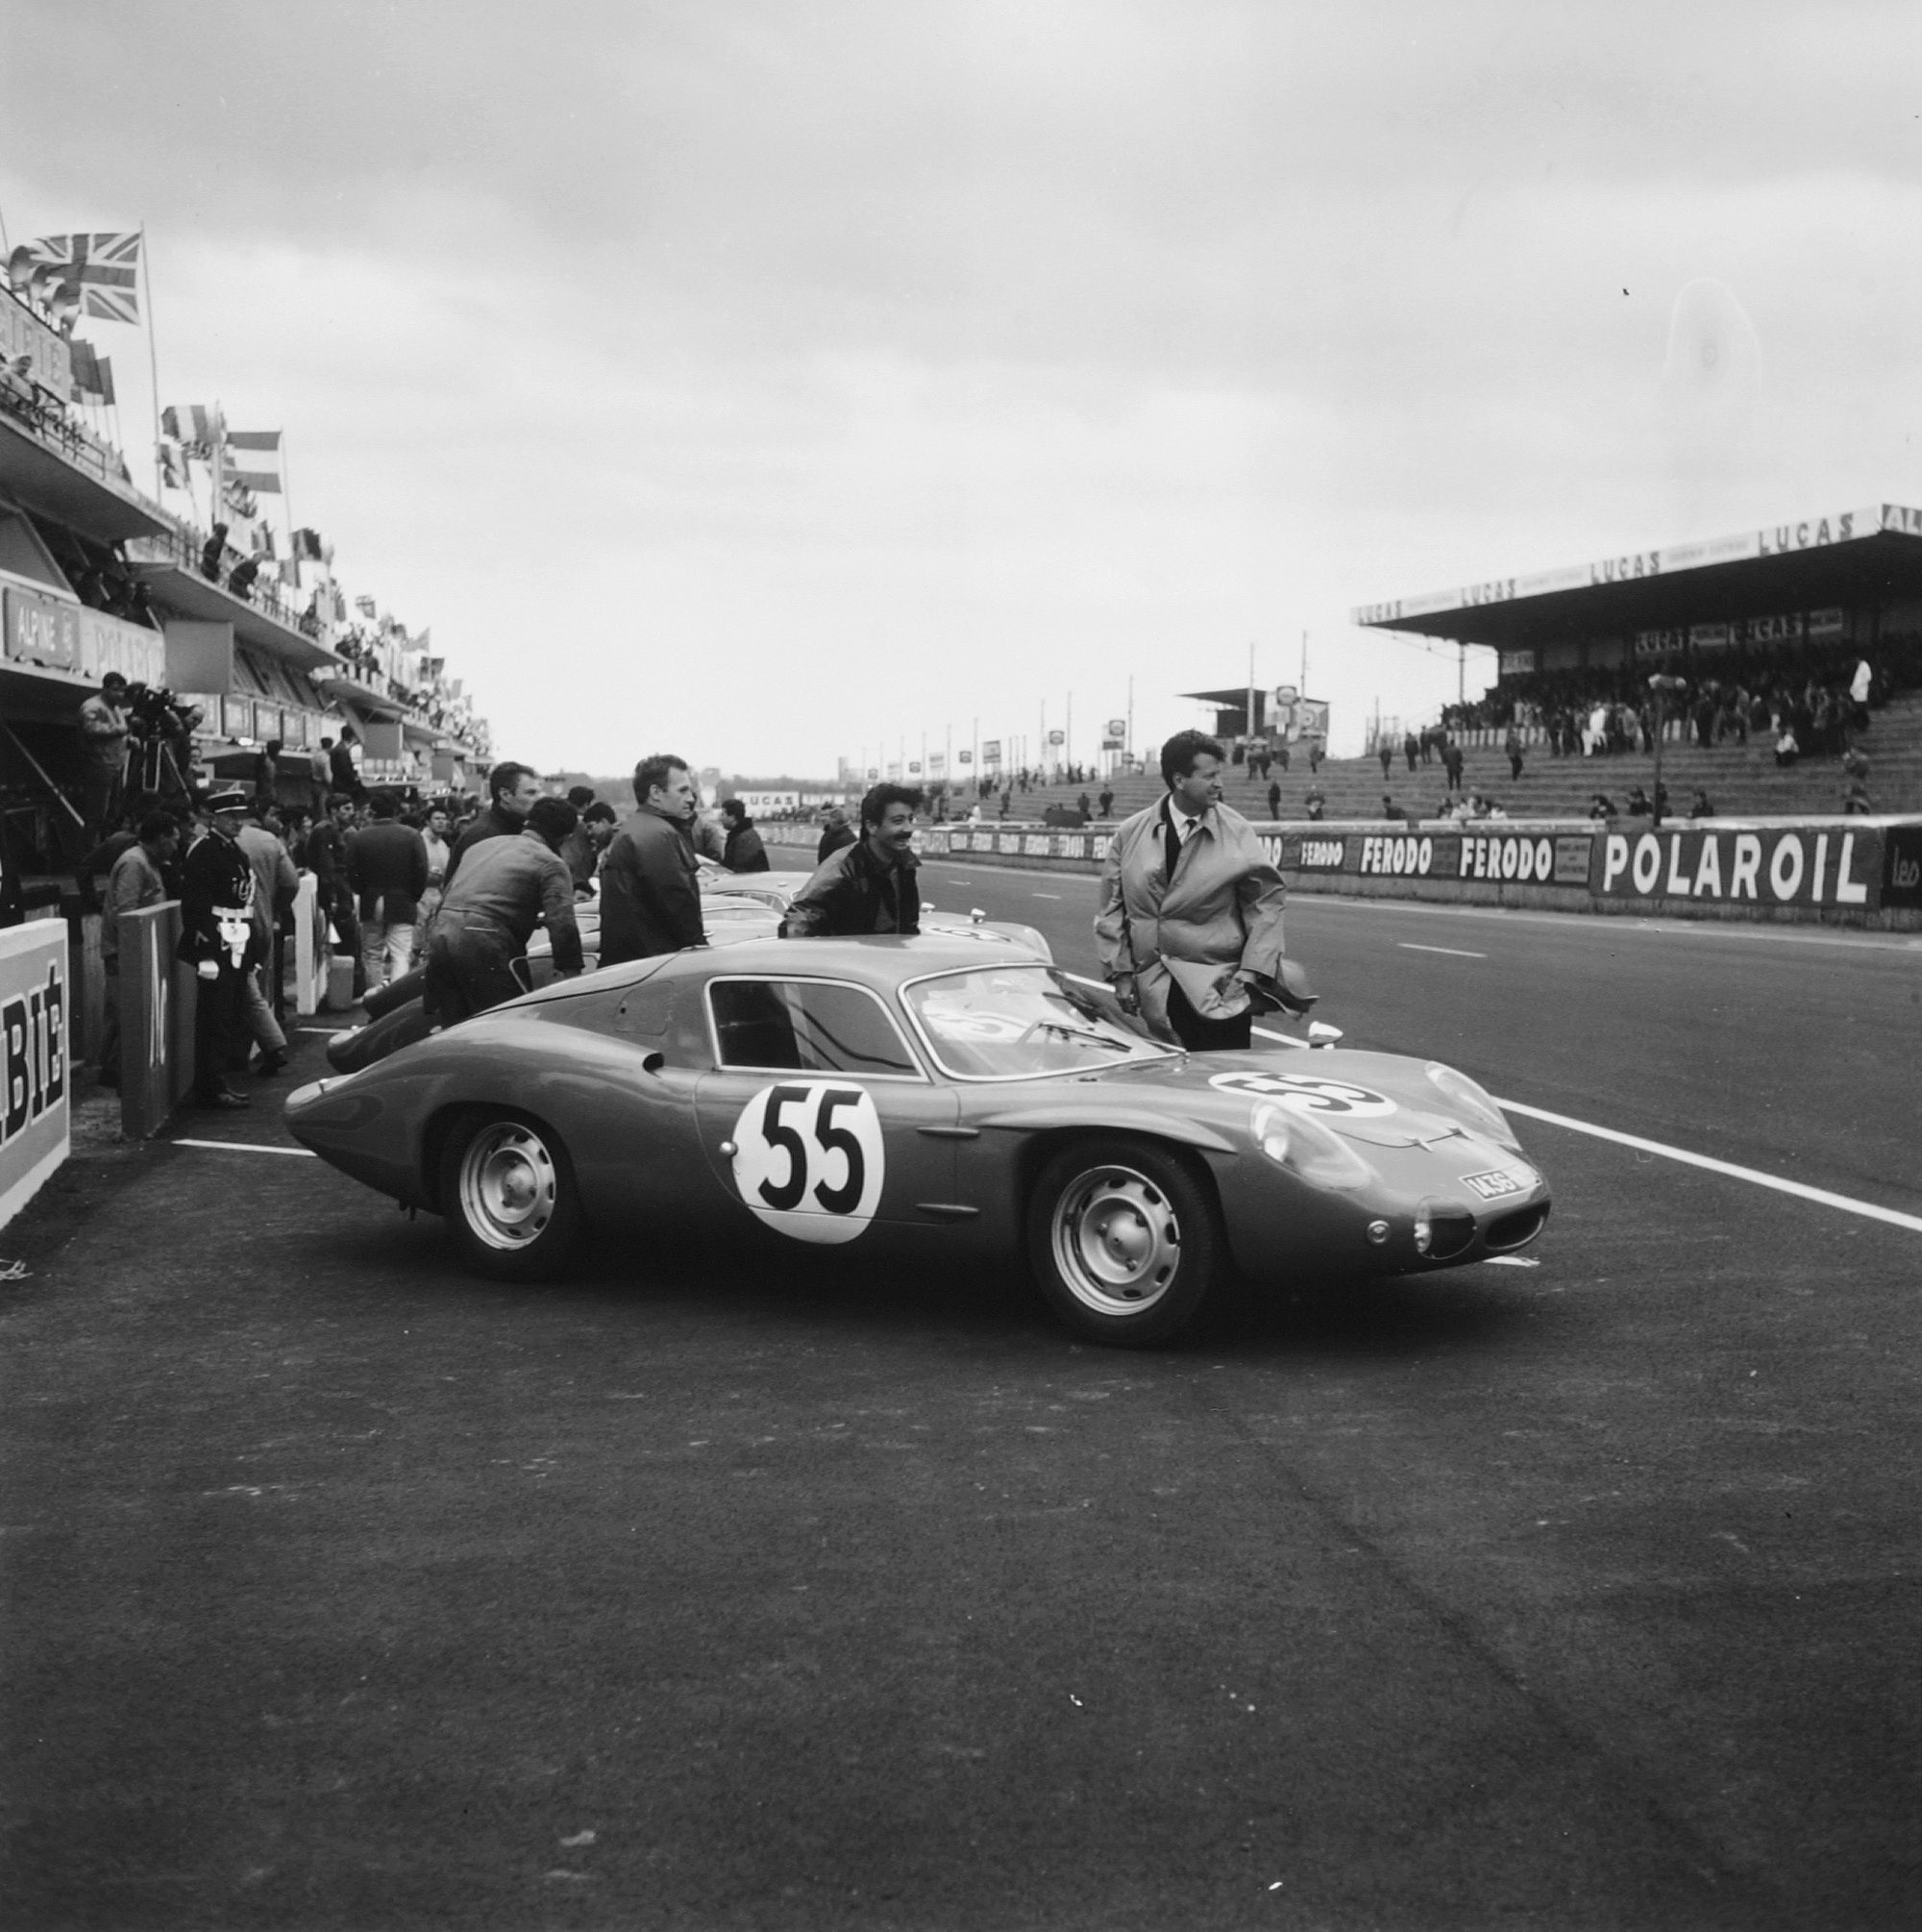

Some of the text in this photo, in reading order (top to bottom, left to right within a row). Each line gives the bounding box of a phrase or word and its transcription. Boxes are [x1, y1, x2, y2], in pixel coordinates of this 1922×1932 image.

[1358, 600, 1401, 625] LUCAS
[1461, 579, 1515, 607] LUCAS
[1589, 551, 1661, 585] LUCAS
[1759, 513, 1854, 557] LUCAS
[740, 796, 794, 805] LUCAS
[1301, 842, 1343, 866] FERODO
[1361, 837, 1433, 875] FERODO
[1460, 837, 1552, 880] FERODO
[1603, 832, 1867, 904] POLAROIL
[1217, 1073, 1386, 1111] 55
[757, 1085, 864, 1215] 55
